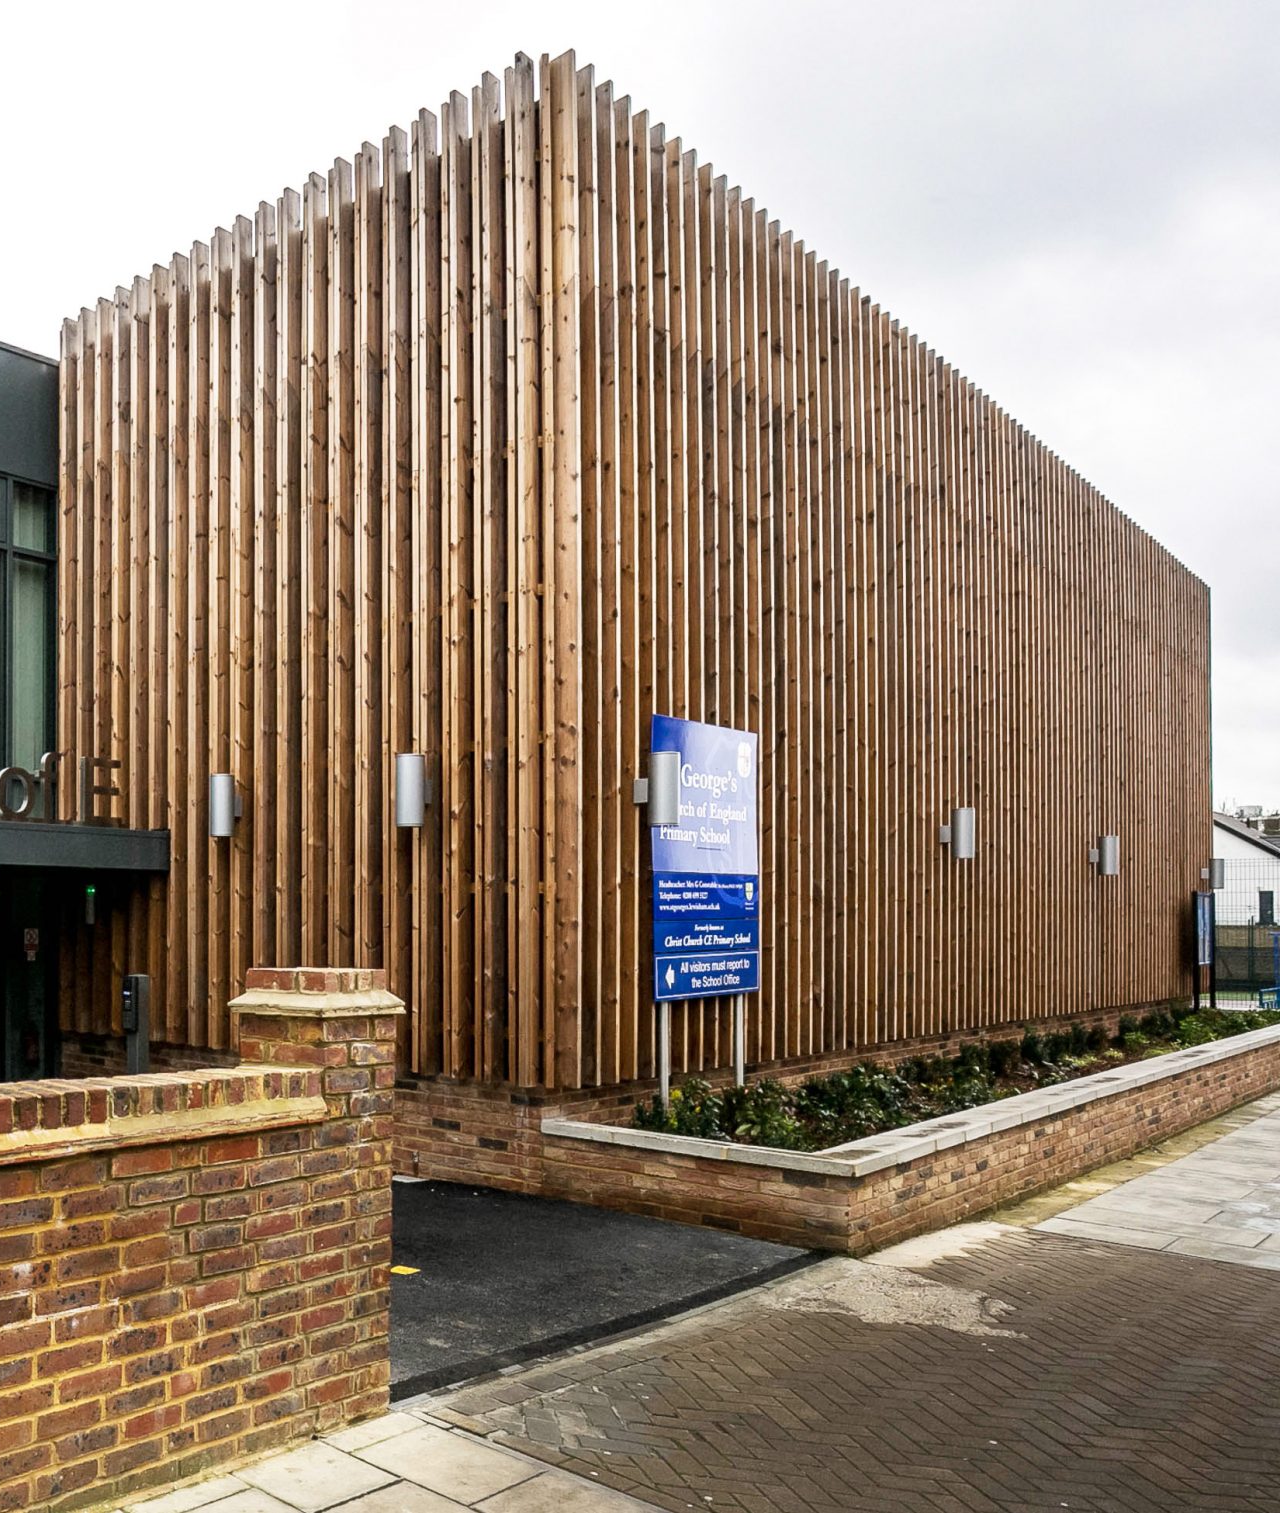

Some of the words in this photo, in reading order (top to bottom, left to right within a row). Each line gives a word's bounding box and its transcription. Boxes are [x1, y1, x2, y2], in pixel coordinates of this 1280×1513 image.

[79, 755, 121, 825] E
[681, 763, 738, 798] George's
[696, 801, 708, 817] of
[709, 803, 747, 825] England
[660, 825, 698, 847] Primary
[700, 826, 730, 844] School
[664, 935, 682, 947] Christ
[683, 935, 703, 946] Church
[713, 935, 734, 948] Primary
[735, 932, 751, 943] School
[680, 961, 689, 973] All
[690, 961, 710, 972] visitors
[711, 960, 726, 970] must
[726, 958, 743, 972] report
[743, 958, 750, 968] to
[691, 977, 701, 988] the
[702, 975, 722, 987] School
[723, 974, 740, 985] Office
